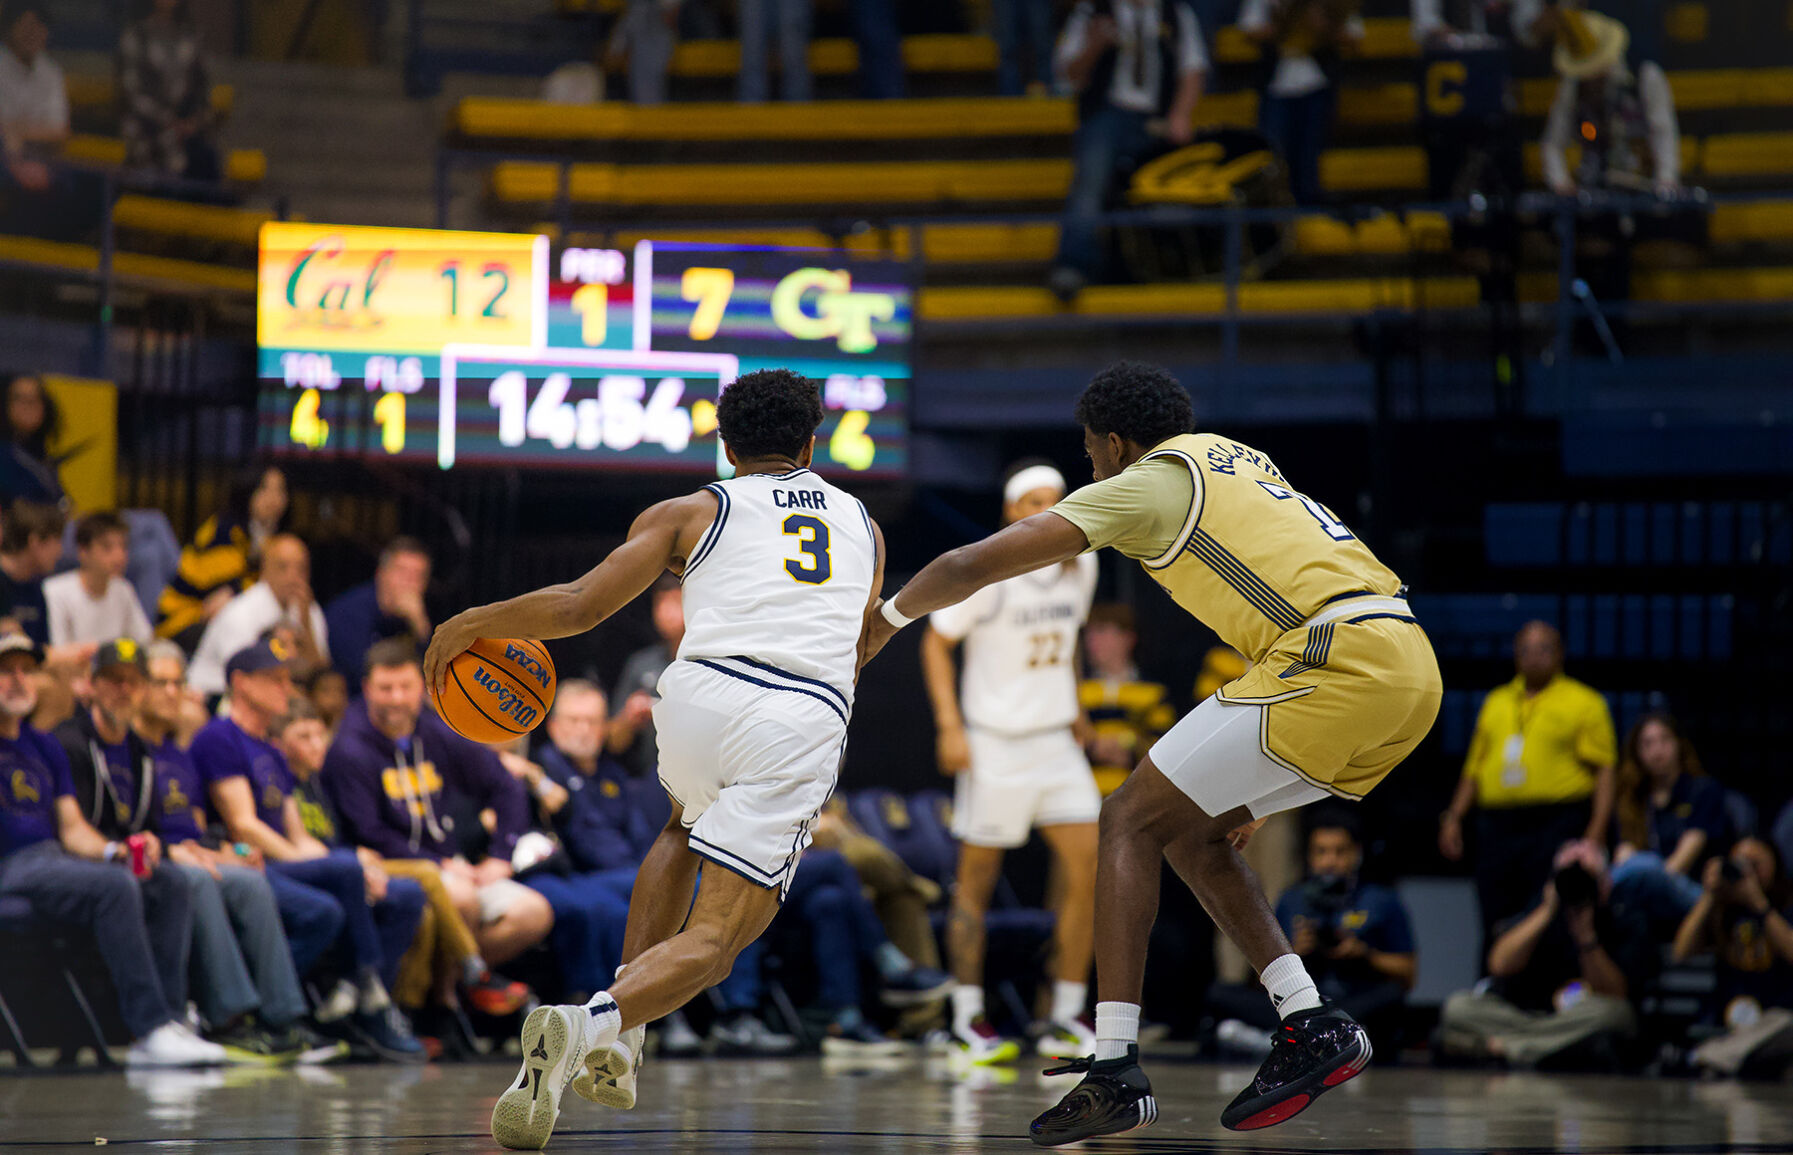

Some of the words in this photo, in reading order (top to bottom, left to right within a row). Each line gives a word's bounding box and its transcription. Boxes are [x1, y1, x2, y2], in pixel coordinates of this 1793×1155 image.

[284, 235, 396, 312] Cal
[440, 262, 509, 318] 12
[681, 266, 735, 340] 7
[571, 282, 608, 346] 1
[771, 267, 895, 353] GT
[374, 392, 406, 454] 1
[488, 370, 692, 453] 14:54
[772, 489, 827, 510] CARR
[782, 513, 832, 586] 3
[473, 665, 538, 728] Wilson
[504, 643, 551, 689] NCAA
